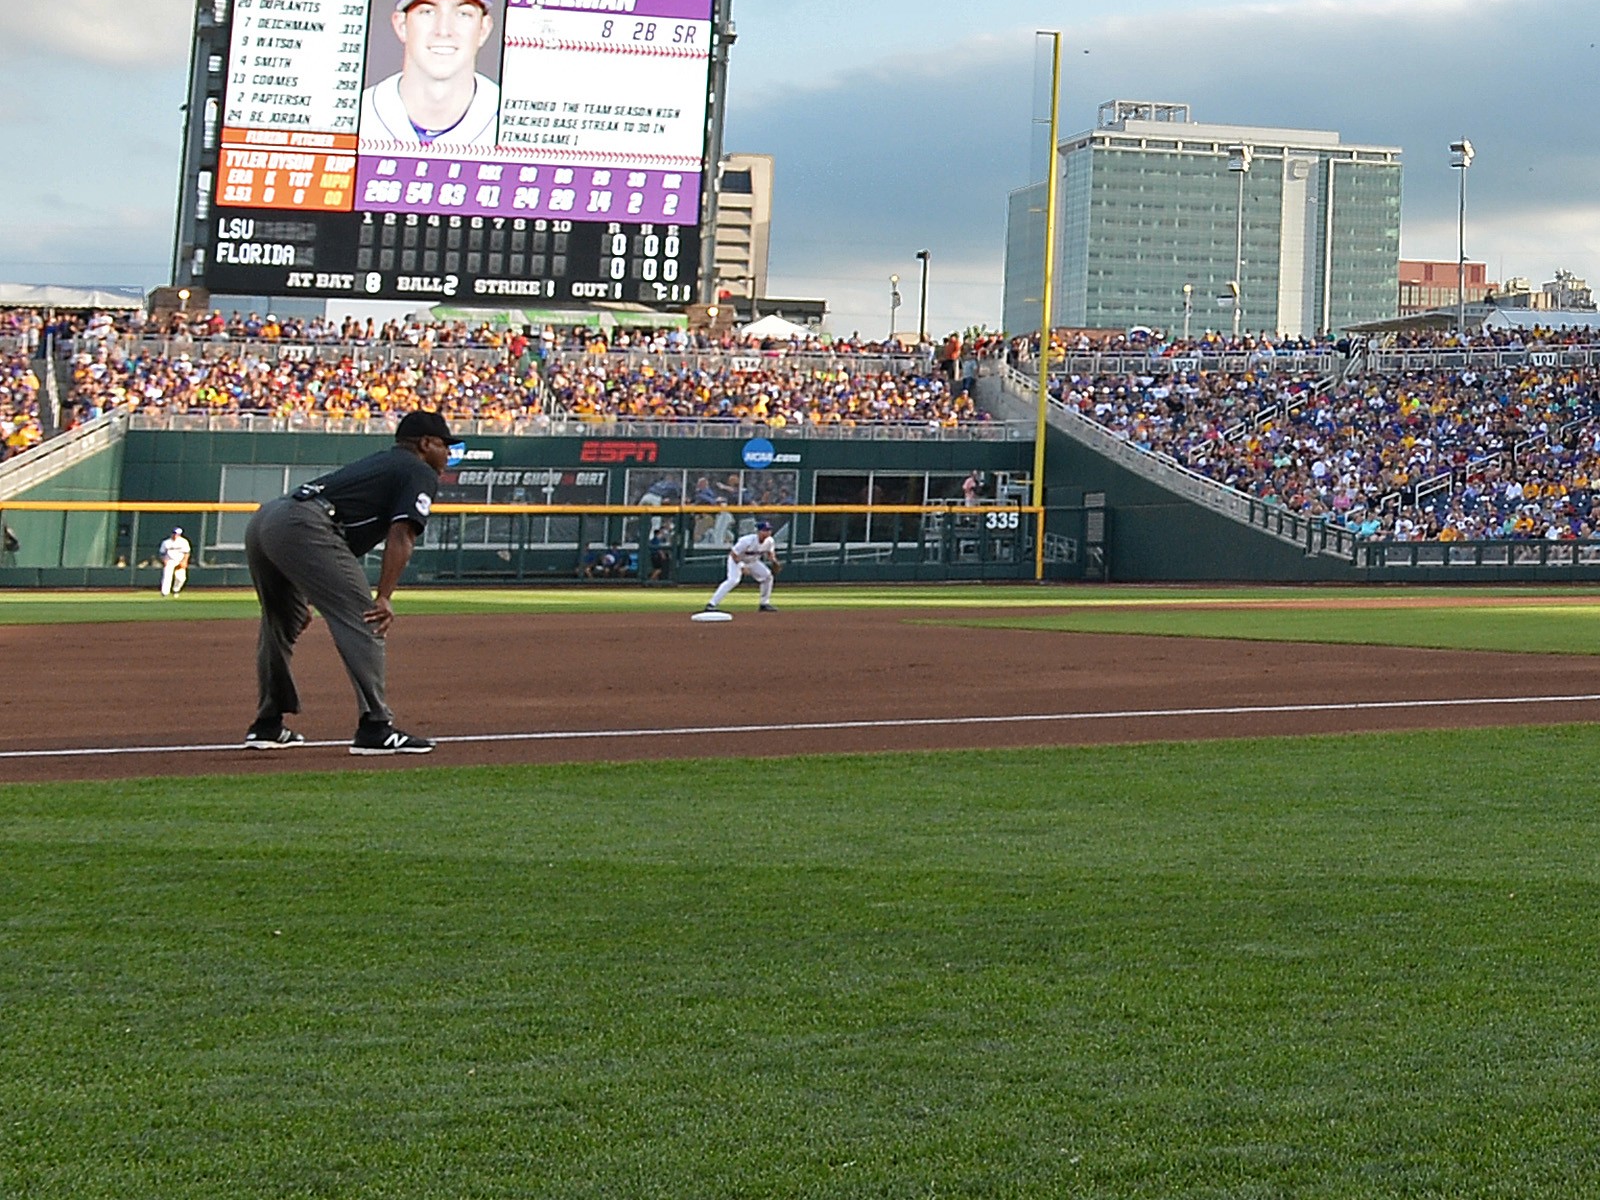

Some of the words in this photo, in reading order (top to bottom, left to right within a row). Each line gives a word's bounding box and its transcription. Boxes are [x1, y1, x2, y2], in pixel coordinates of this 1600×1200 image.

[244, 17, 252, 27] 7
[601, 20, 614, 38] 8
[633, 22, 656, 41] 2B
[672, 26, 696, 44] SR
[256, 36, 303, 50] WATSON
[240, 55, 247, 65] 4
[254, 55, 292, 68] SMITH
[232, 73, 246, 84] 13
[505, 99, 556, 111] EXTENDED
[563, 102, 579, 113] THE
[584, 103, 612, 114] TEAM
[614, 105, 652, 116] SEASON
[503, 116, 550, 127] REACHED
[553, 118, 579, 129] BASE
[581, 120, 619, 131] STREAK
[653, 124, 666, 134] IN
[502, 131, 539, 143] FINALS
[542, 133, 570, 145] GAME
[226, 151, 268, 168] TYLER
[364, 179, 402, 203] 266
[405, 181, 434, 205] 54
[475, 185, 501, 208] 41
[512, 186, 540, 210] 24
[586, 190, 612, 213] 14
[627, 192, 644, 214] 2
[662, 194, 679, 216] 2
[362, 212, 374, 225] 1
[383, 212, 396, 225] 2
[405, 213, 418, 226] 3
[427, 215, 440, 227] 4
[449, 216, 461, 228] 5
[471, 216, 483, 229] 6
[492, 218, 505, 230] 7
[513, 218, 526, 231] 8
[534, 220, 547, 232] 9
[552, 220, 572, 232] 10
[218, 218, 254, 239] LSU
[612, 233, 627, 256] 0
[644, 234, 659, 257] 0
[664, 236, 680, 258] 0
[216, 242, 295, 265] FLORIDA
[610, 257, 626, 280] 0
[642, 258, 658, 281] 0
[663, 259, 678, 281] 0
[287, 272, 314, 287] AT
[315, 273, 355, 289] BAT
[365, 272, 382, 293] 8
[396, 276, 443, 292] BALL
[443, 275, 459, 296] 2
[474, 279, 540, 296] STRIKE
[546, 280, 555, 297] 1
[571, 282, 608, 297] OUT
[614, 282, 622, 299] 1
[580, 441, 658, 462] ESPN
[458, 471, 522, 485] GREATEST
[575, 472, 606, 485] DIRT
[986, 512, 1019, 529] 335
